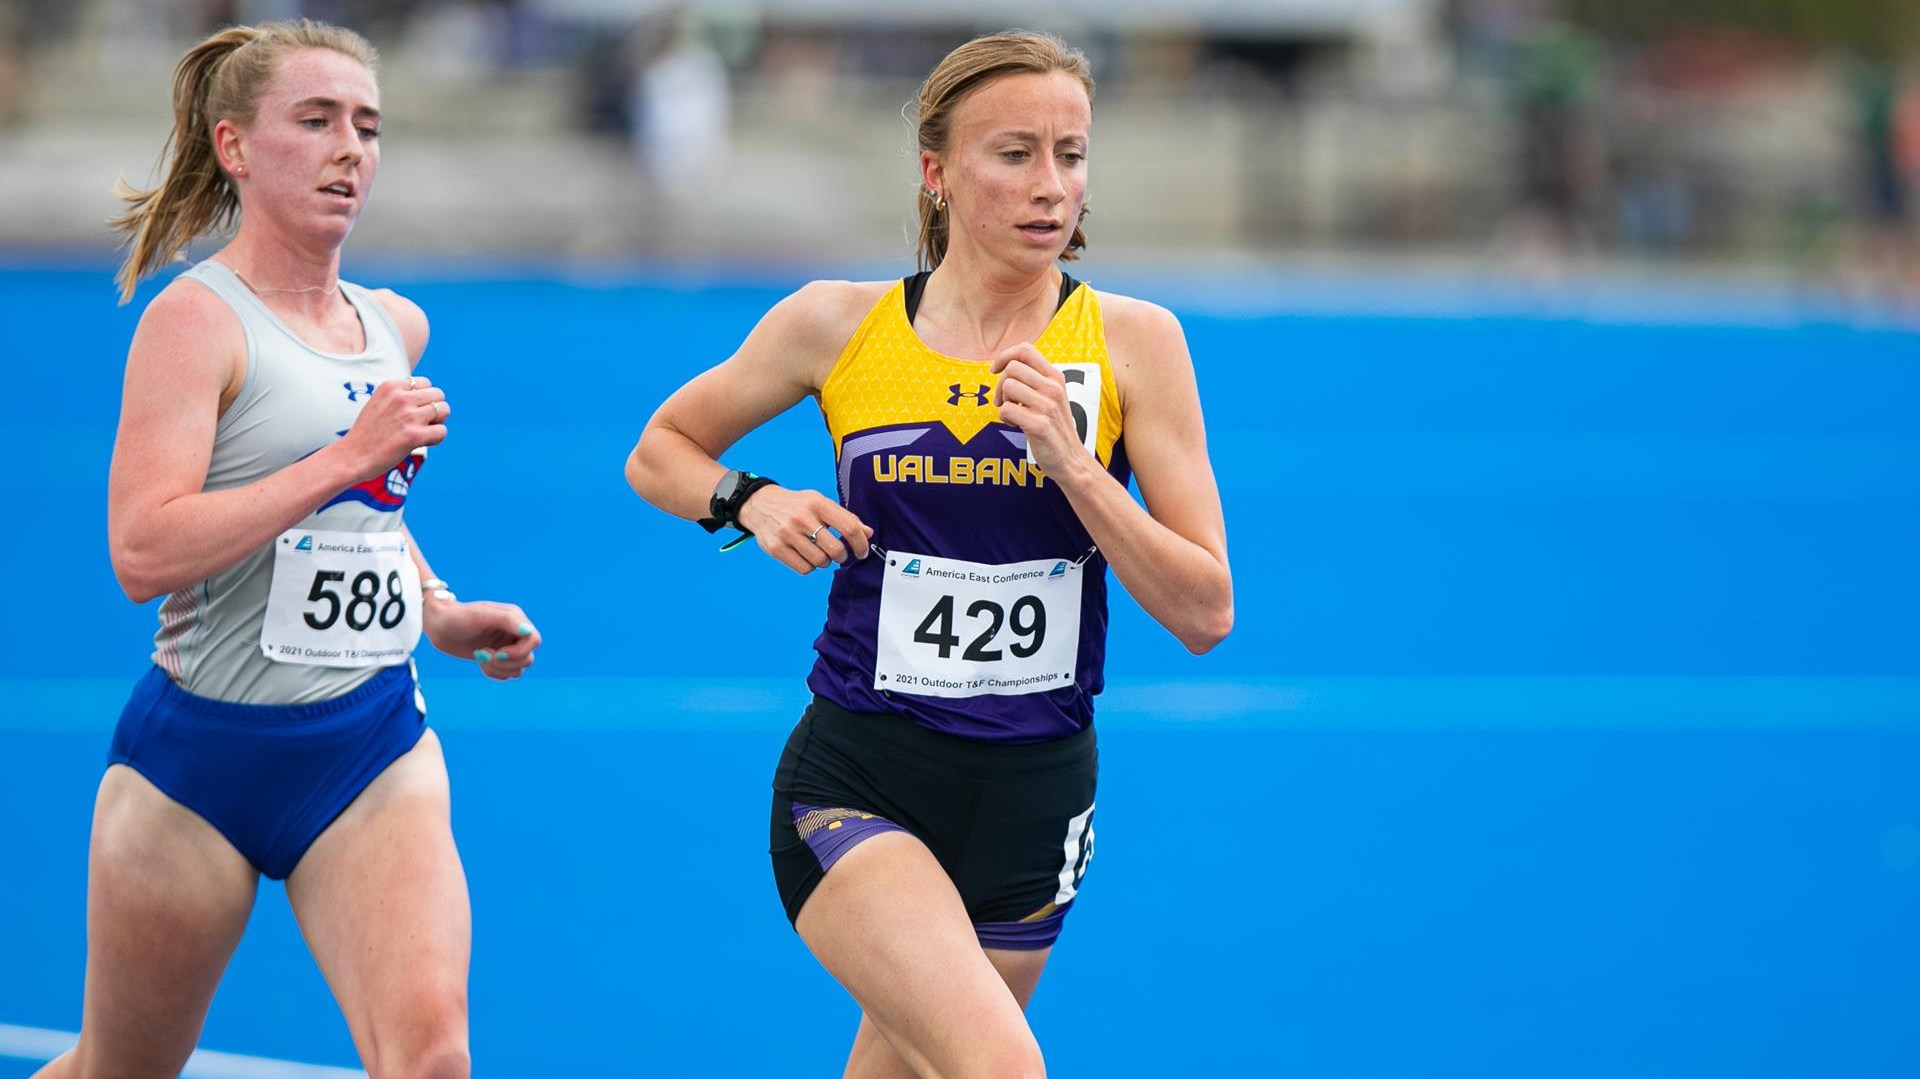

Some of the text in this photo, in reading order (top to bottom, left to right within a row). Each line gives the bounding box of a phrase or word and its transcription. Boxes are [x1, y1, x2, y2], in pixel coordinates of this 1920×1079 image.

[873, 454, 1048, 488] UALBANY
[318, 543, 355, 553] America
[926, 567, 1045, 584] America East Conference
[303, 569, 406, 632] 588
[913, 594, 1047, 662] 429
[280, 645, 302, 655] 2021
[305, 648, 341, 658] Outdoor
[895, 672, 1059, 689] 2021 Outdoor T&F Championships
